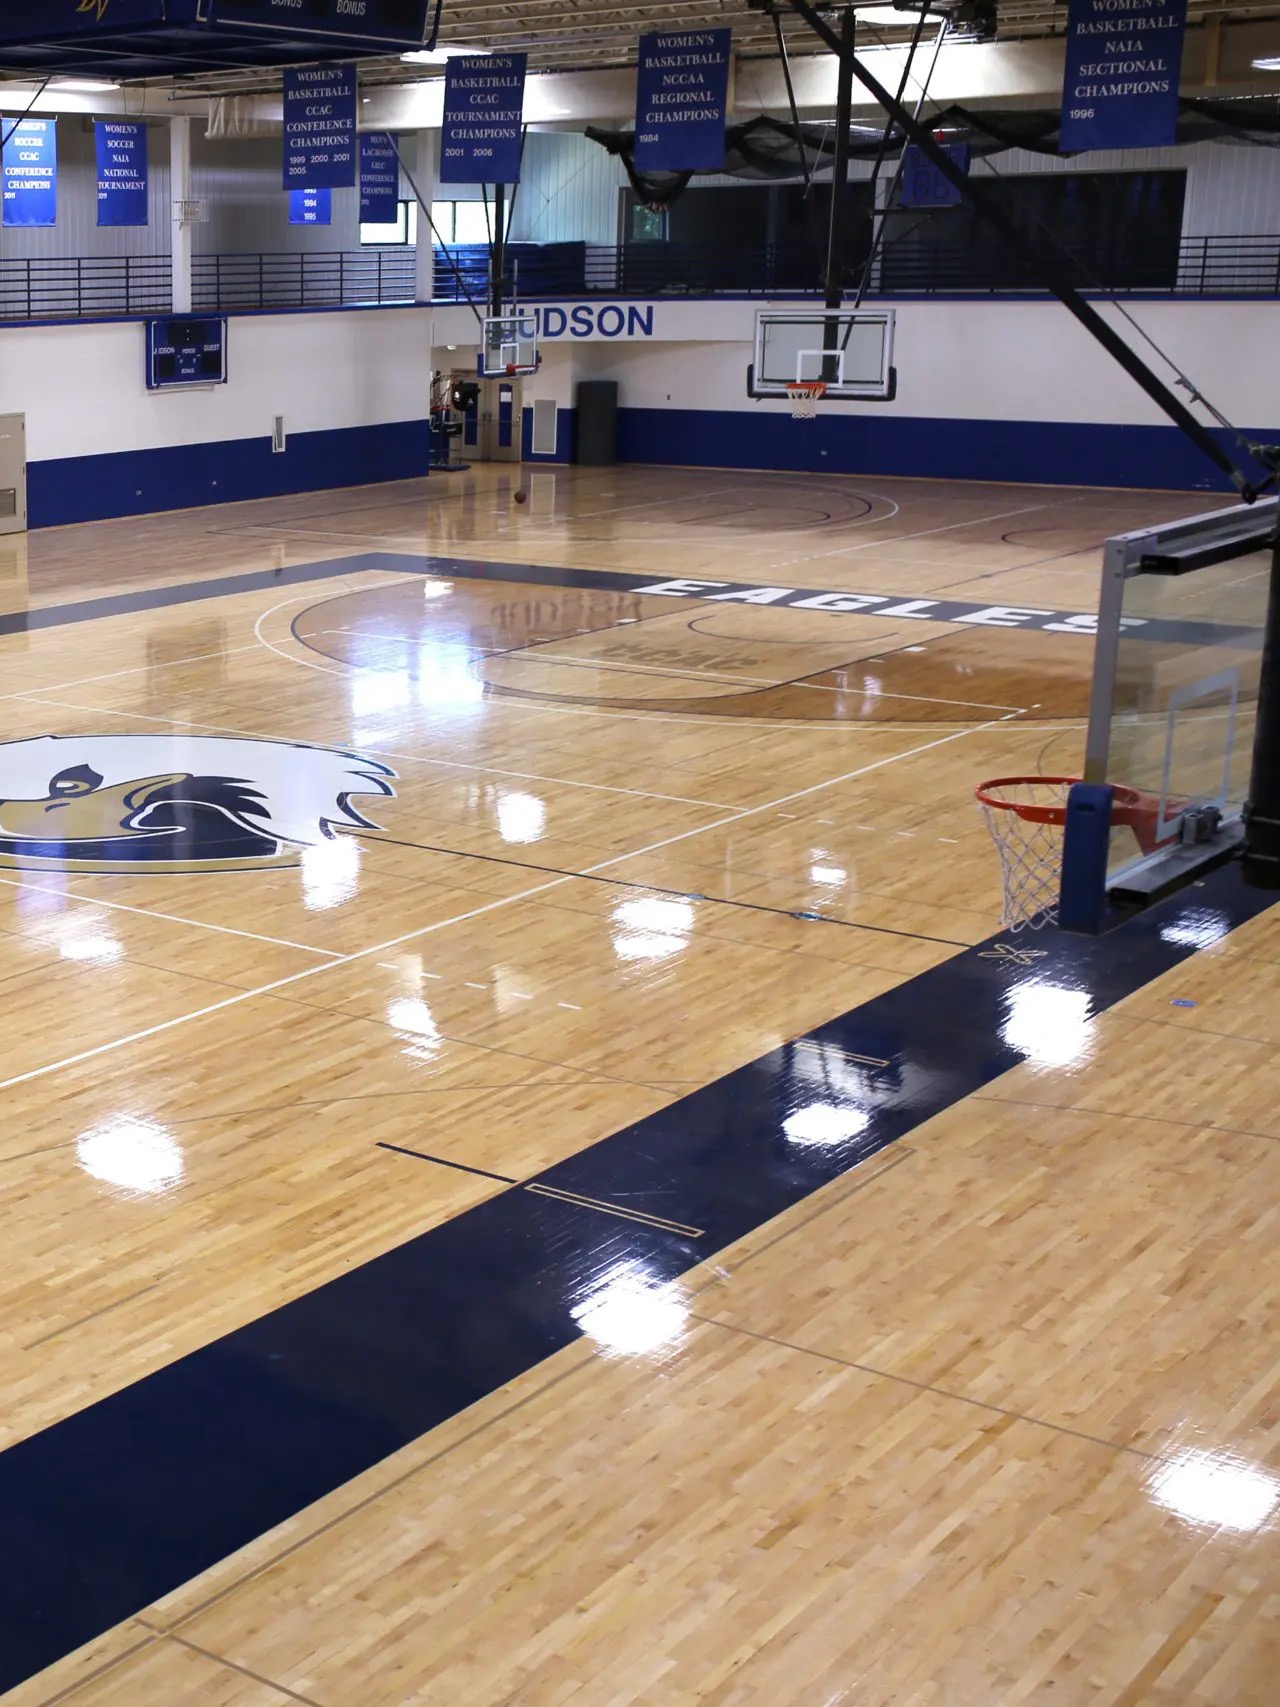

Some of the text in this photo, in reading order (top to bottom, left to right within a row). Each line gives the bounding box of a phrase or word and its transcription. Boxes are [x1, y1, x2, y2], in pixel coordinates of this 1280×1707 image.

[337, 0, 366, 15] BONUS
[1092, 0, 1166, 12] WOMENS
[1076, 15, 1178, 35] BASKETBALL
[657, 34, 714, 48] WOMEN'S
[1104, 40, 1144, 54] NAIA
[461, 58, 512, 69] WOMEN'S
[645, 52, 725, 68] BASKETBALL
[1079, 59, 1167, 76] SECTIONAL
[297, 69, 343, 81] WOMEN'S
[662, 73, 704, 86] NCCAA
[451, 76, 520, 89] BASKETBALL
[287, 86, 351, 100] BASKETBALL
[1075, 80, 1169, 98] CHAMPIONS
[470, 94, 499, 104] CCAC
[652, 91, 714, 104] REGIONAL
[306, 105, 332, 116] CCAC
[646, 109, 719, 123] CHAMPIONS
[1069, 108, 1095, 119] 1996
[446, 111, 522, 122] TOURNAMENT
[105, 124, 137, 134] WOMEN'S
[287, 119, 353, 132] CONFERENCE
[450, 128, 516, 139] CHAMPIONS
[639, 134, 659, 142] 1984
[14, 137, 44, 147] SOCCER
[107, 139, 134, 149] SOCCER
[290, 135, 349, 148] CHAMPIONS
[445, 148, 464, 156] 2001
[112, 154, 129, 162] NAIA
[289, 153, 350, 164] 1999 2000 2001
[5, 167, 53, 177] CONFERENCE
[104, 168, 139, 177] NATIONAL
[8, 180, 51, 190] CHAMPIONS
[98, 181, 145, 190] TOURNAMENT
[628, 578, 1151, 636] EAGLES
